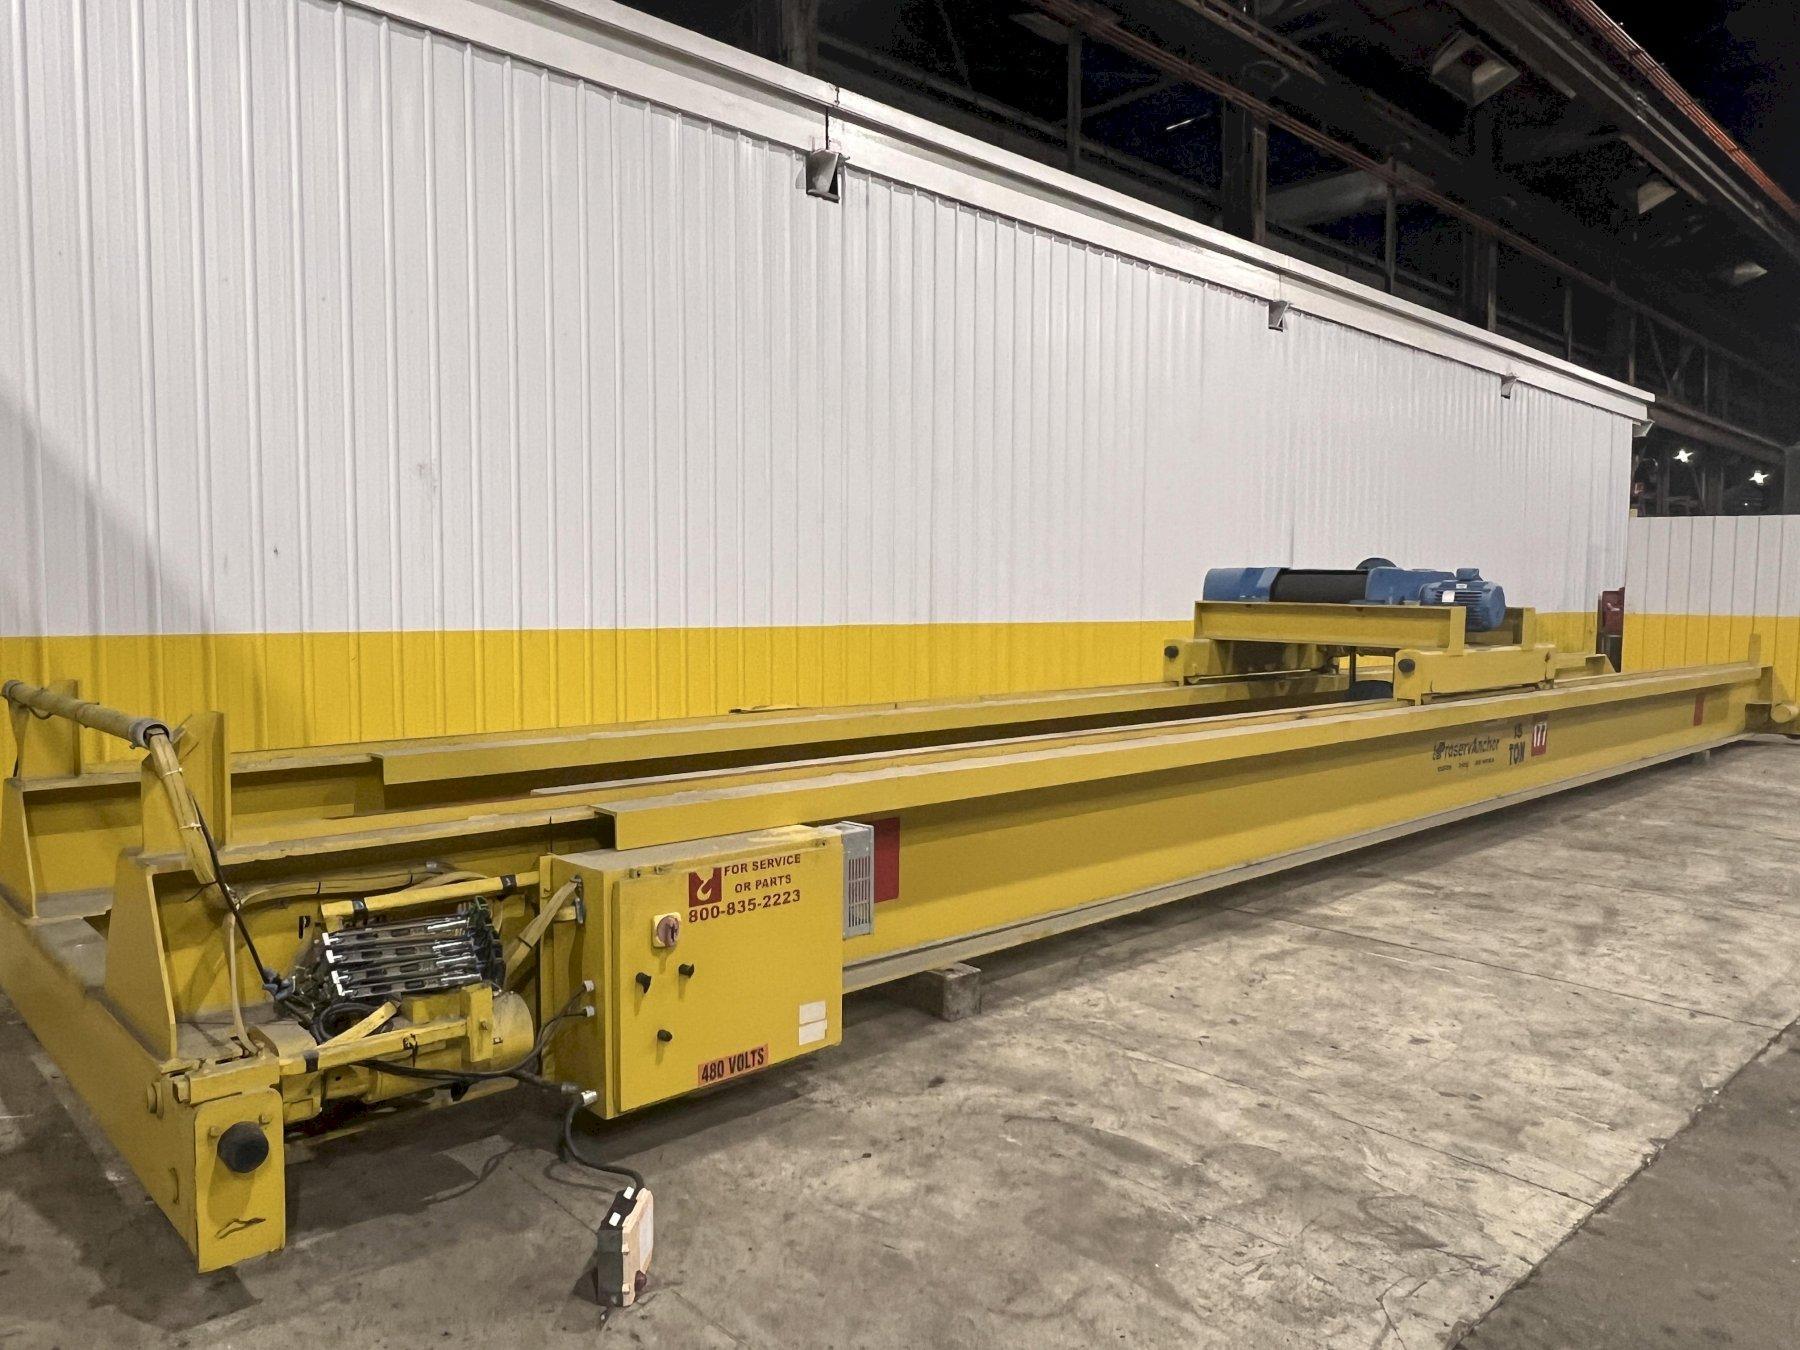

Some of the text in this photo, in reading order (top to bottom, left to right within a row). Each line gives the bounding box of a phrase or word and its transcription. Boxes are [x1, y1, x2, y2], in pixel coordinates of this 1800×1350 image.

[1509, 741, 1526, 766] TON
[724, 854, 801, 876] FOR SERVICE
[735, 874, 791, 893] OR PARTS
[688, 889, 801, 923] 800-835-2223
[701, 1047, 764, 1082] 480 VOLTS
